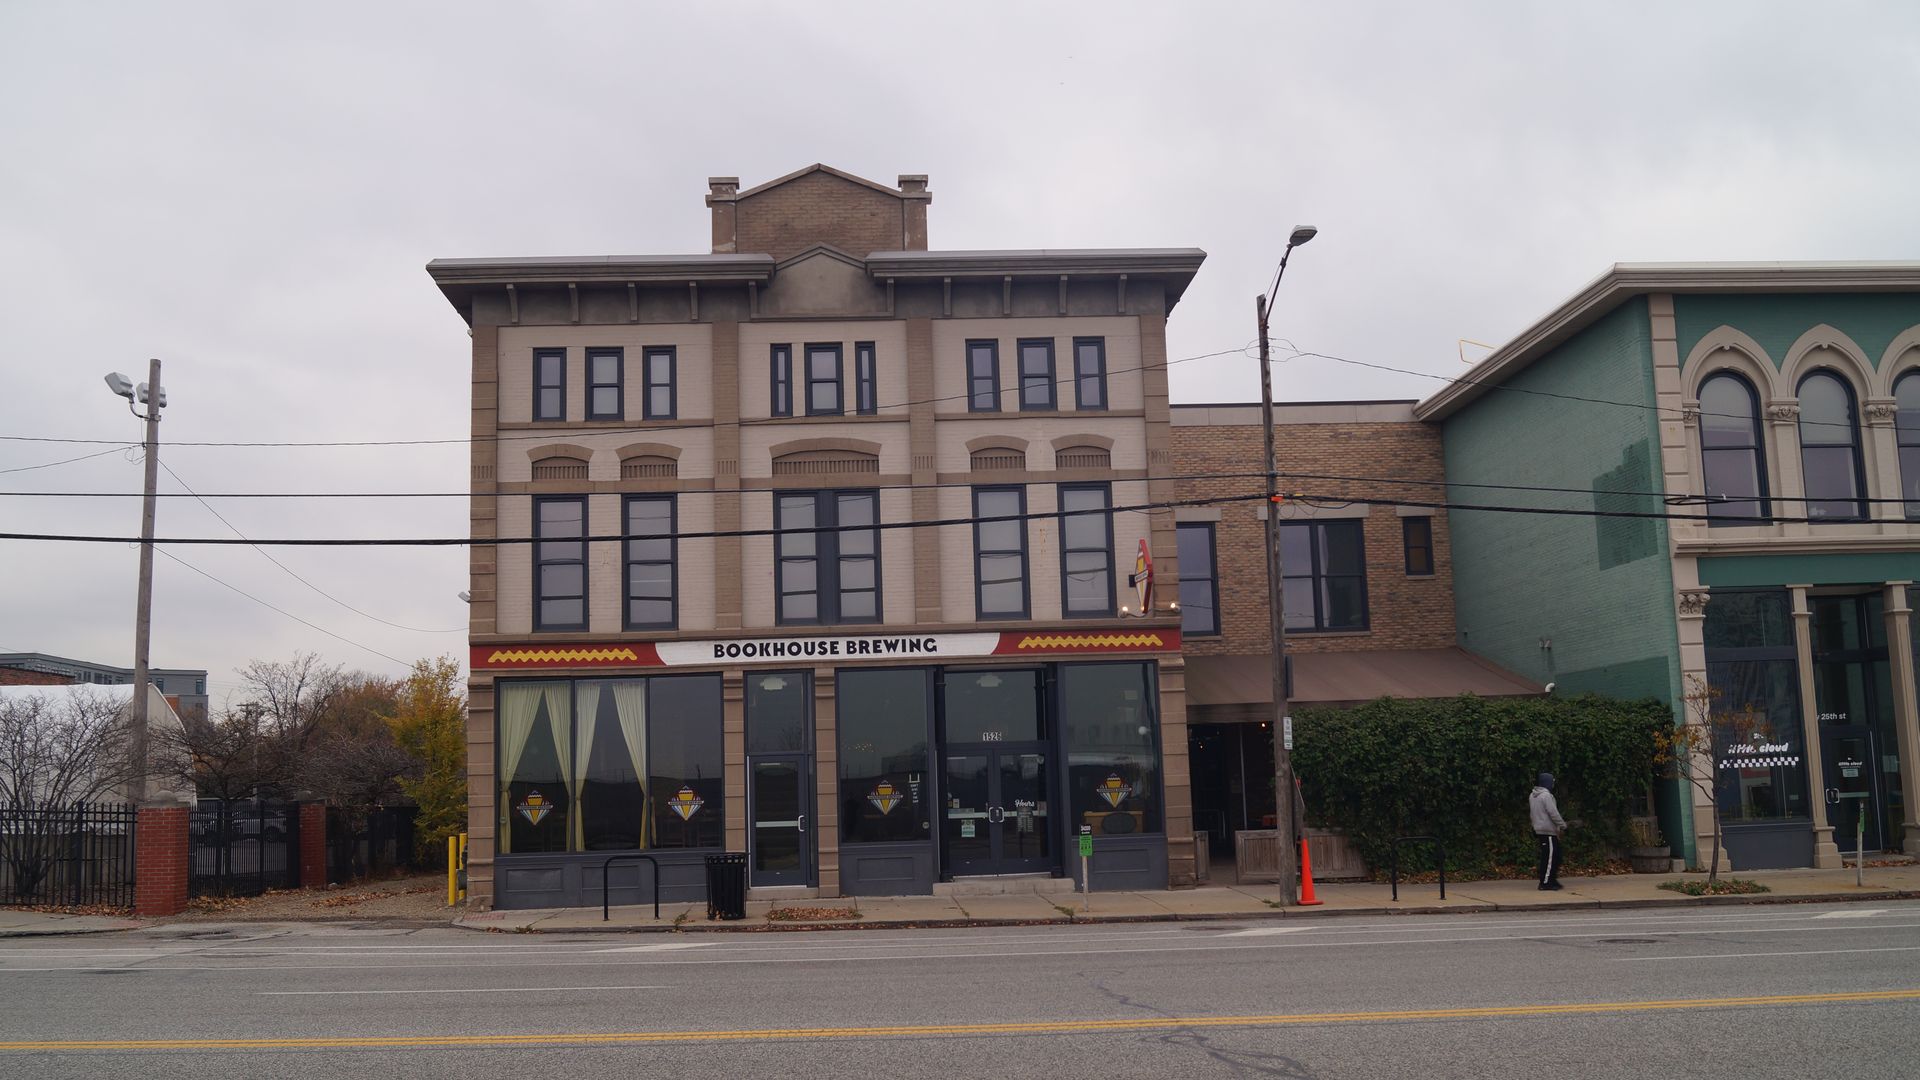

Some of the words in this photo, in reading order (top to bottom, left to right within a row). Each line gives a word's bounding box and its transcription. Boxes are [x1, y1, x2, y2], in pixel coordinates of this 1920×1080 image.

[714, 641, 839, 658] BOOKHOUSE
[846, 638, 938, 655] BREWING
[1759, 742, 1789, 753] cloud
[1014, 798, 1035, 808] Hours
